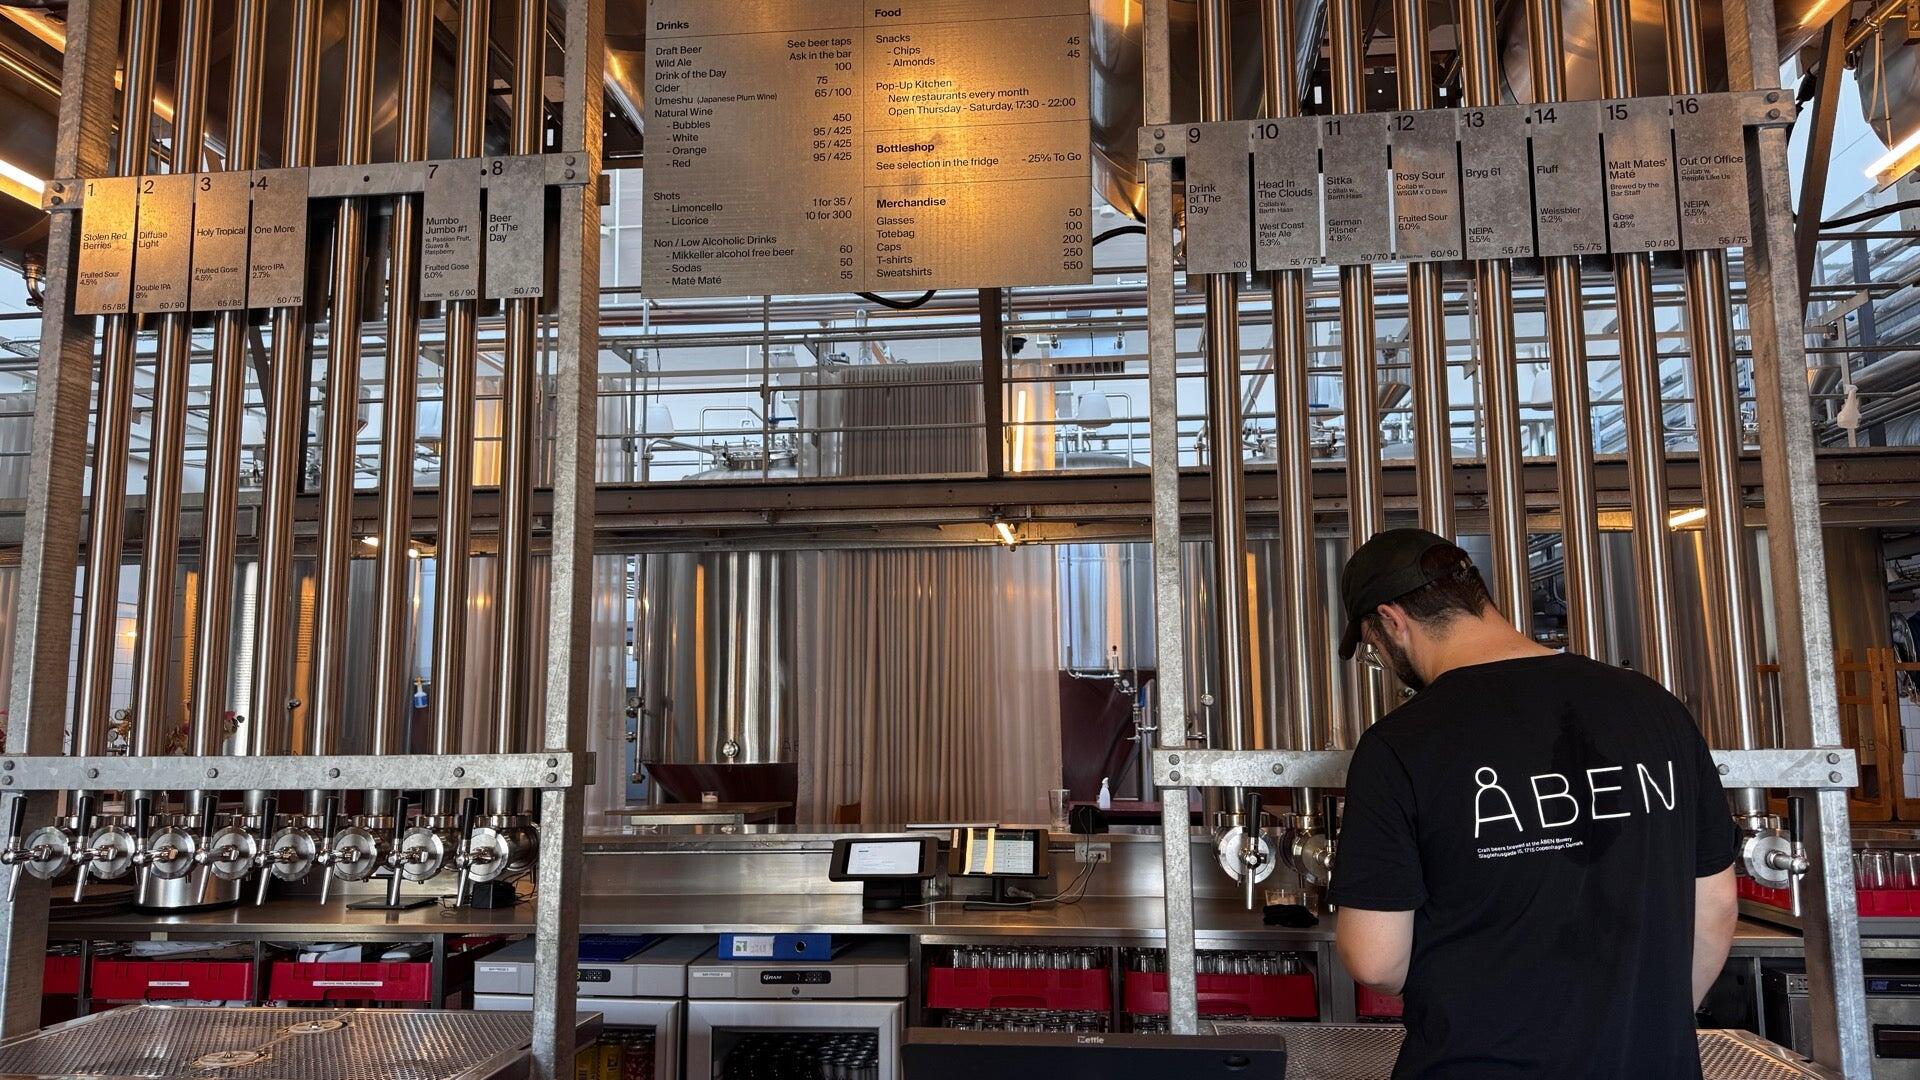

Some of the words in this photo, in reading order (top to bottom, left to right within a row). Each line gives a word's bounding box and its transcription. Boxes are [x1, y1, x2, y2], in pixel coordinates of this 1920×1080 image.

[875, 8, 901, 18] Food
[656, 21, 689, 30] Drinks
[787, 40, 805, 48] See
[807, 38, 829, 47] beer
[831, 37, 852, 47] taps
[876, 34, 911, 44] Snacks
[1067, 37, 1080, 45] 45
[656, 47, 678, 56] Draft
[680, 46, 702, 54] Beer
[789, 52, 807, 61] Ask
[809, 52, 817, 60] in
[819, 51, 834, 59] the
[836, 50, 852, 58] bar
[893, 46, 921, 56] Chips
[1067, 50, 1080, 58] 45
[656, 60, 675, 68] Wild
[677, 59, 692, 67] Ale
[835, 63, 852, 71] 100
[893, 57, 936, 67] Almonds
[656, 72, 679, 80] Drink
[681, 71, 691, 79] of
[709, 69, 727, 78] Day
[817, 76, 828, 84] 75
[876, 81, 913, 91] Pop-Up
[915, 79, 952, 89] Kitchen
[655, 84, 680, 93] Cider
[888, 94, 909, 103] New
[912, 91, 967, 102] restaurants
[969, 90, 996, 100] every
[997, 88, 1029, 98] month
[655, 97, 693, 106] Umeshu
[1676, 98, 1699, 115] 16
[889, 107, 915, 117] Open
[918, 105, 961, 115] Thursday
[969, 102, 1014, 112] Saturday,
[1016, 100, 1039, 109] 17:30
[1047, 98, 1076, 108] 22:00
[1606, 104, 1628, 121] 15
[655, 109, 688, 118] Natural
[690, 108, 713, 116] Wine
[833, 114, 852, 122] 450
[1534, 108, 1557, 124] 14
[1395, 116, 1414, 131] 12
[1463, 111, 1485, 128] 13
[672, 121, 710, 130] Bubbles
[1326, 120, 1341, 136] 11
[1188, 128, 1200, 143] 9
[1257, 123, 1279, 139] 10
[672, 134, 699, 142] White
[672, 146, 707, 155] Orange
[877, 143, 935, 154] Bottleshop
[1028, 154, 1052, 163] 25%
[1053, 153, 1065, 162] To
[1067, 152, 1082, 161] Go
[1679, 157, 1698, 166] Out
[1700, 156, 1712, 165] Of
[1714, 155, 1743, 164] Office
[492, 161, 503, 175] 8
[672, 159, 691, 168] Red
[876, 161, 895, 170] See
[897, 159, 941, 169] selection
[943, 159, 951, 167] in
[953, 158, 969, 167] the
[971, 157, 999, 166] fridge
[1634, 159, 1667, 168] Mates'
[428, 164, 439, 179] 7
[1465, 169, 1488, 179] Bryg
[1491, 167, 1501, 176] 61
[1537, 165, 1559, 174] Fluff
[1609, 169, 1635, 180] Maté
[1327, 177, 1352, 185] Sitka
[1396, 172, 1420, 182] Rosy
[1422, 171, 1445, 180] Sour
[144, 180, 154, 194] 2
[201, 177, 211, 191] 3
[257, 176, 268, 190] 4
[1258, 180, 1284, 189] Head
[1286, 179, 1295, 188] In
[88, 183, 94, 197] 1
[1189, 184, 1216, 194] Drink
[1258, 190, 1277, 198] The
[1279, 188, 1313, 198] Clouds
[653, 192, 680, 201] Shots
[1190, 194, 1199, 204] of
[1202, 194, 1221, 203] The
[672, 203, 723, 213] Limoncello
[877, 197, 946, 209] Merchandise
[1069, 208, 1082, 217] 50
[1189, 205, 1209, 215] Day
[1540, 207, 1581, 215] Weissbier
[426, 217, 459, 225] Mumbo
[490, 214, 512, 222] Beer
[672, 216, 709, 226] Licorice
[877, 216, 915, 225] Glasses
[1329, 218, 1362, 226] German
[1398, 215, 1427, 223] Fruited
[1612, 213, 1634, 221] Gose
[255, 226, 272, 234] One
[274, 225, 295, 233] More
[426, 226, 456, 235] Jumbo
[458, 225, 467, 233] #1
[489, 224, 499, 232] of
[501, 223, 518, 231] The
[1065, 221, 1083, 230] 100
[1281, 222, 1304, 230] Coast
[140, 231, 168, 239] Diffuse
[197, 229, 214, 237] Holy
[216, 227, 246, 236] Tropical
[877, 229, 915, 239] Totebag
[1469, 227, 1494, 235] NEIPA
[84, 233, 110, 241] Stolen
[111, 232, 127, 240] Red
[489, 234, 507, 243] Day
[654, 239, 673, 248] Non
[681, 238, 700, 247] Low
[702, 236, 745, 246] Alcoholic
[747, 235, 777, 245] Drinks
[1063, 235, 1083, 244] 200
[83, 242, 112, 250] Berries
[139, 239, 159, 249] Light
[877, 243, 902, 252] Caps
[672, 250, 714, 260] Mikkeller
[716, 250, 750, 259] alcohol
[752, 248, 771, 257] free
[772, 247, 794, 256] beer
[840, 245, 853, 254] 60
[1063, 248, 1083, 257] 250
[840, 258, 853, 266] 50
[877, 255, 913, 265] T-shirts
[672, 264, 702, 272] Sodas
[1063, 261, 1083, 270] 550
[840, 271, 853, 279] 55
[877, 267, 932, 278] Sweatshirts
[672, 277, 696, 286] Maté
[697, 276, 722, 285] Maté
[1474, 760, 1675, 839] ÅBEN
